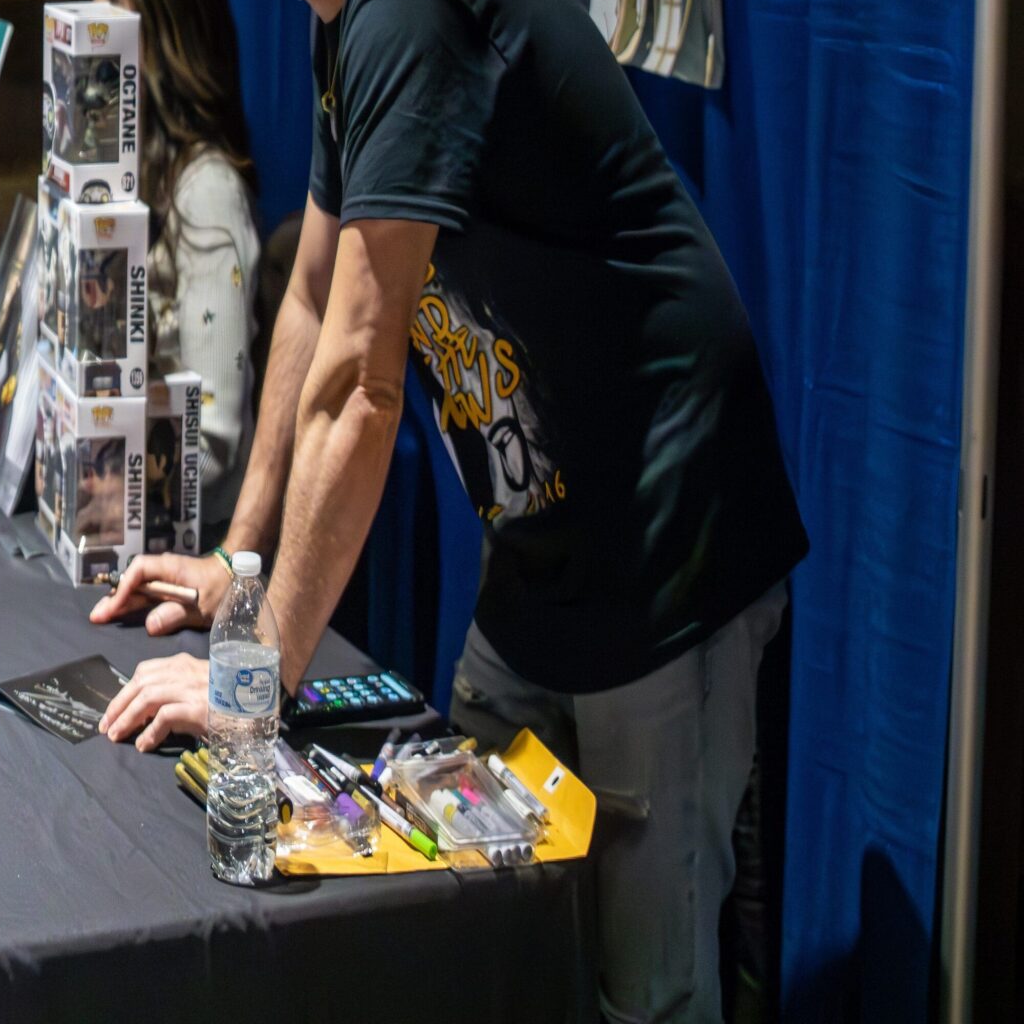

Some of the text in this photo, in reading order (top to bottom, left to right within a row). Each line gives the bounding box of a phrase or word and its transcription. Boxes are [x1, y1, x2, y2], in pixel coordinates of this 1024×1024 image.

[121, 64, 137, 154] OCTANE
[130, 265, 145, 343] SHINKI
[185, 385, 200, 448] SHISUI
[127, 453, 143, 531] SHINKI
[182, 452, 199, 522] UCHIHA
